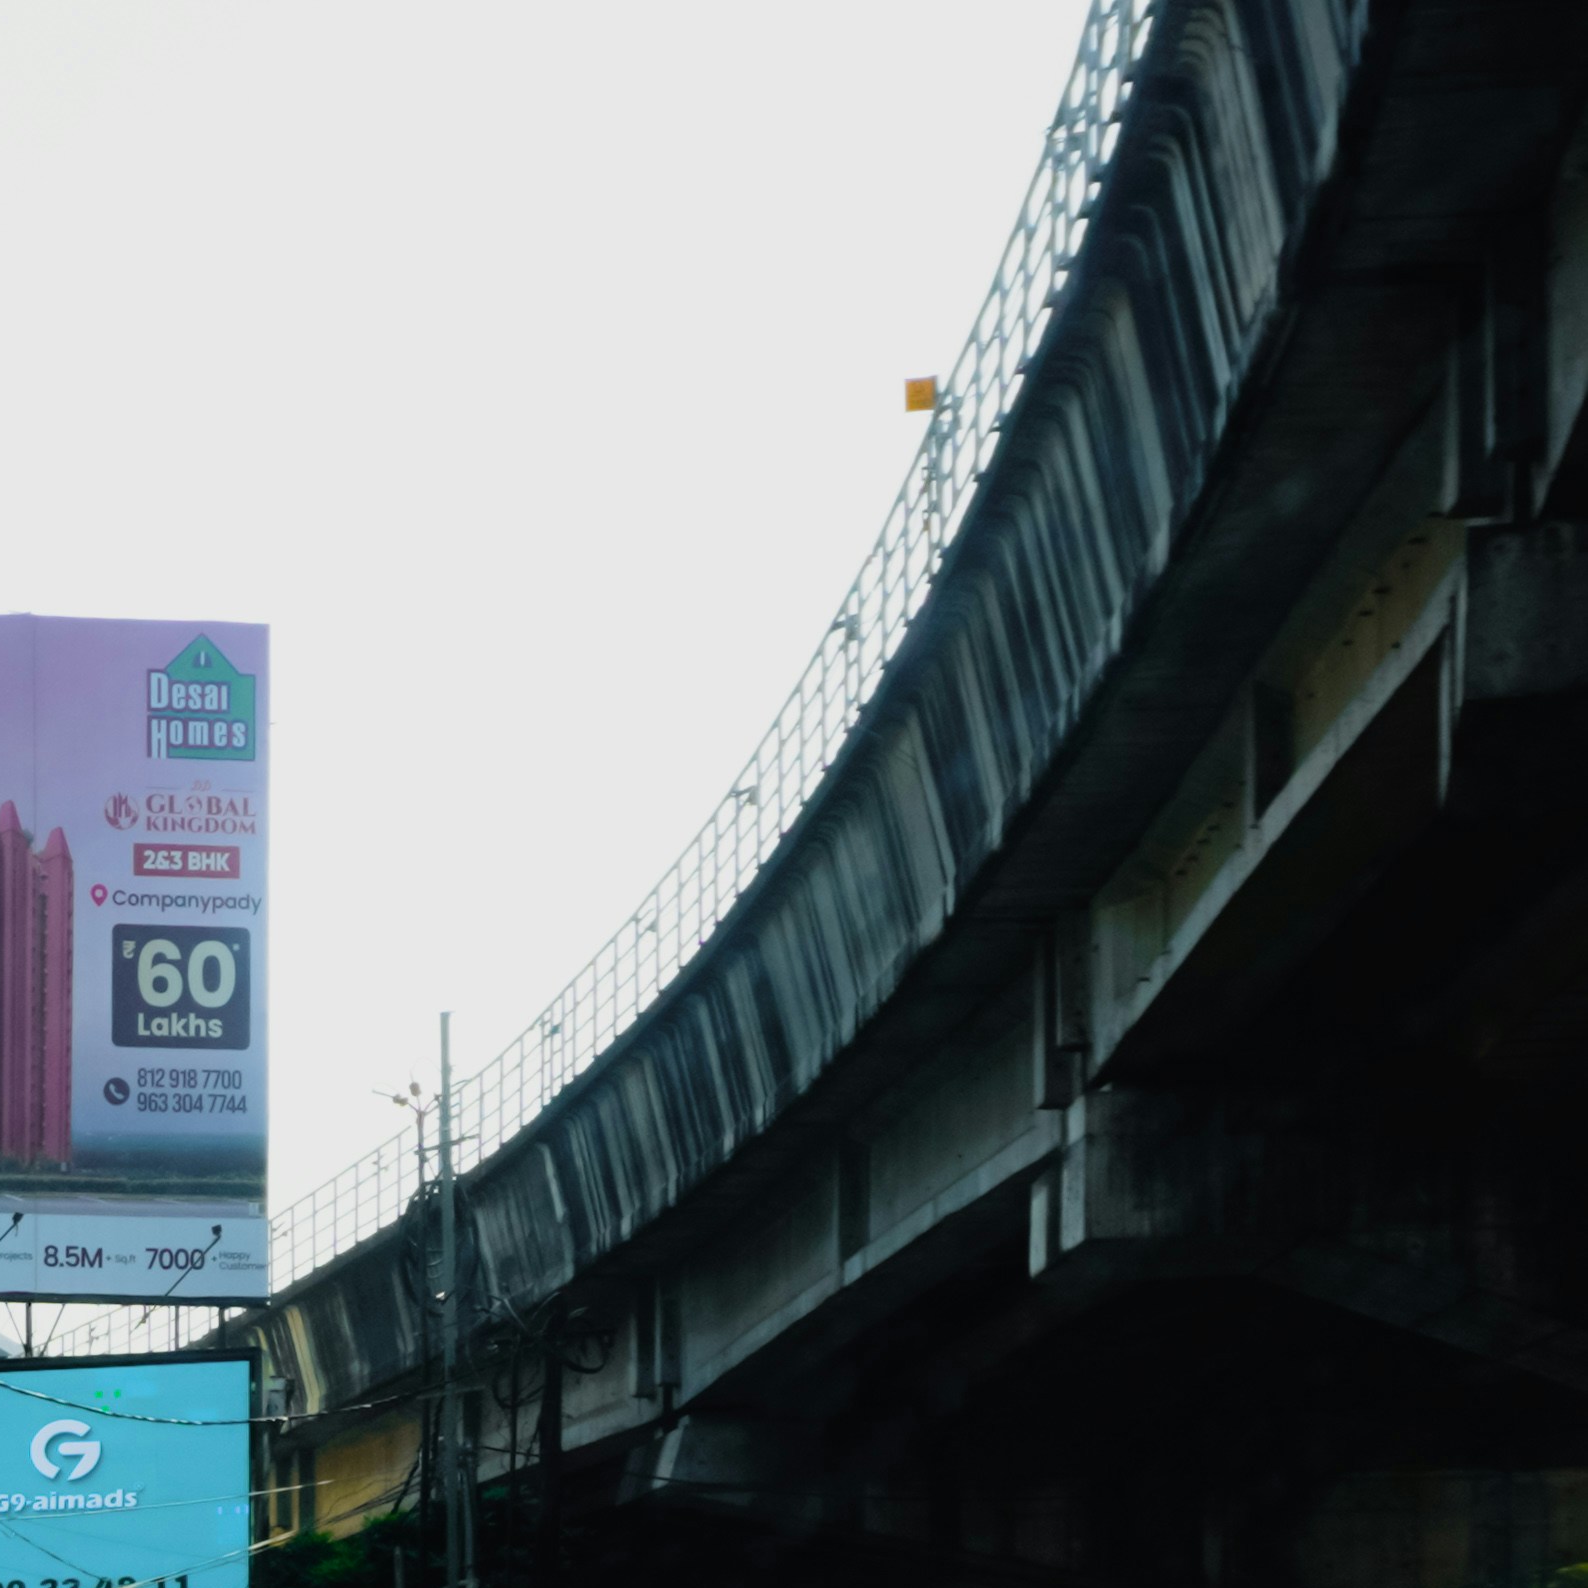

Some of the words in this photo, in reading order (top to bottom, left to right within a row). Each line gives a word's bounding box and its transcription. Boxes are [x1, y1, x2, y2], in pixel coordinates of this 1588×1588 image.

[150, 718, 248, 760] Homes
[145, 815, 257, 835] KINGDOM
[143, 849, 183, 870] 2&3
[187, 851, 231, 872] BHK
[112, 889, 263, 916] Companypady
[136, 1012, 223, 1039] Lakhs
[136, 1067, 163, 1090] 812
[167, 1067, 200, 1091] 918
[204, 1068, 243, 1091] 7700
[136, 1091, 167, 1113] 963
[170, 1092, 205, 1114] 304
[207, 1092, 248, 1115] 7744
[218, 1251, 252, 1263] Happy
